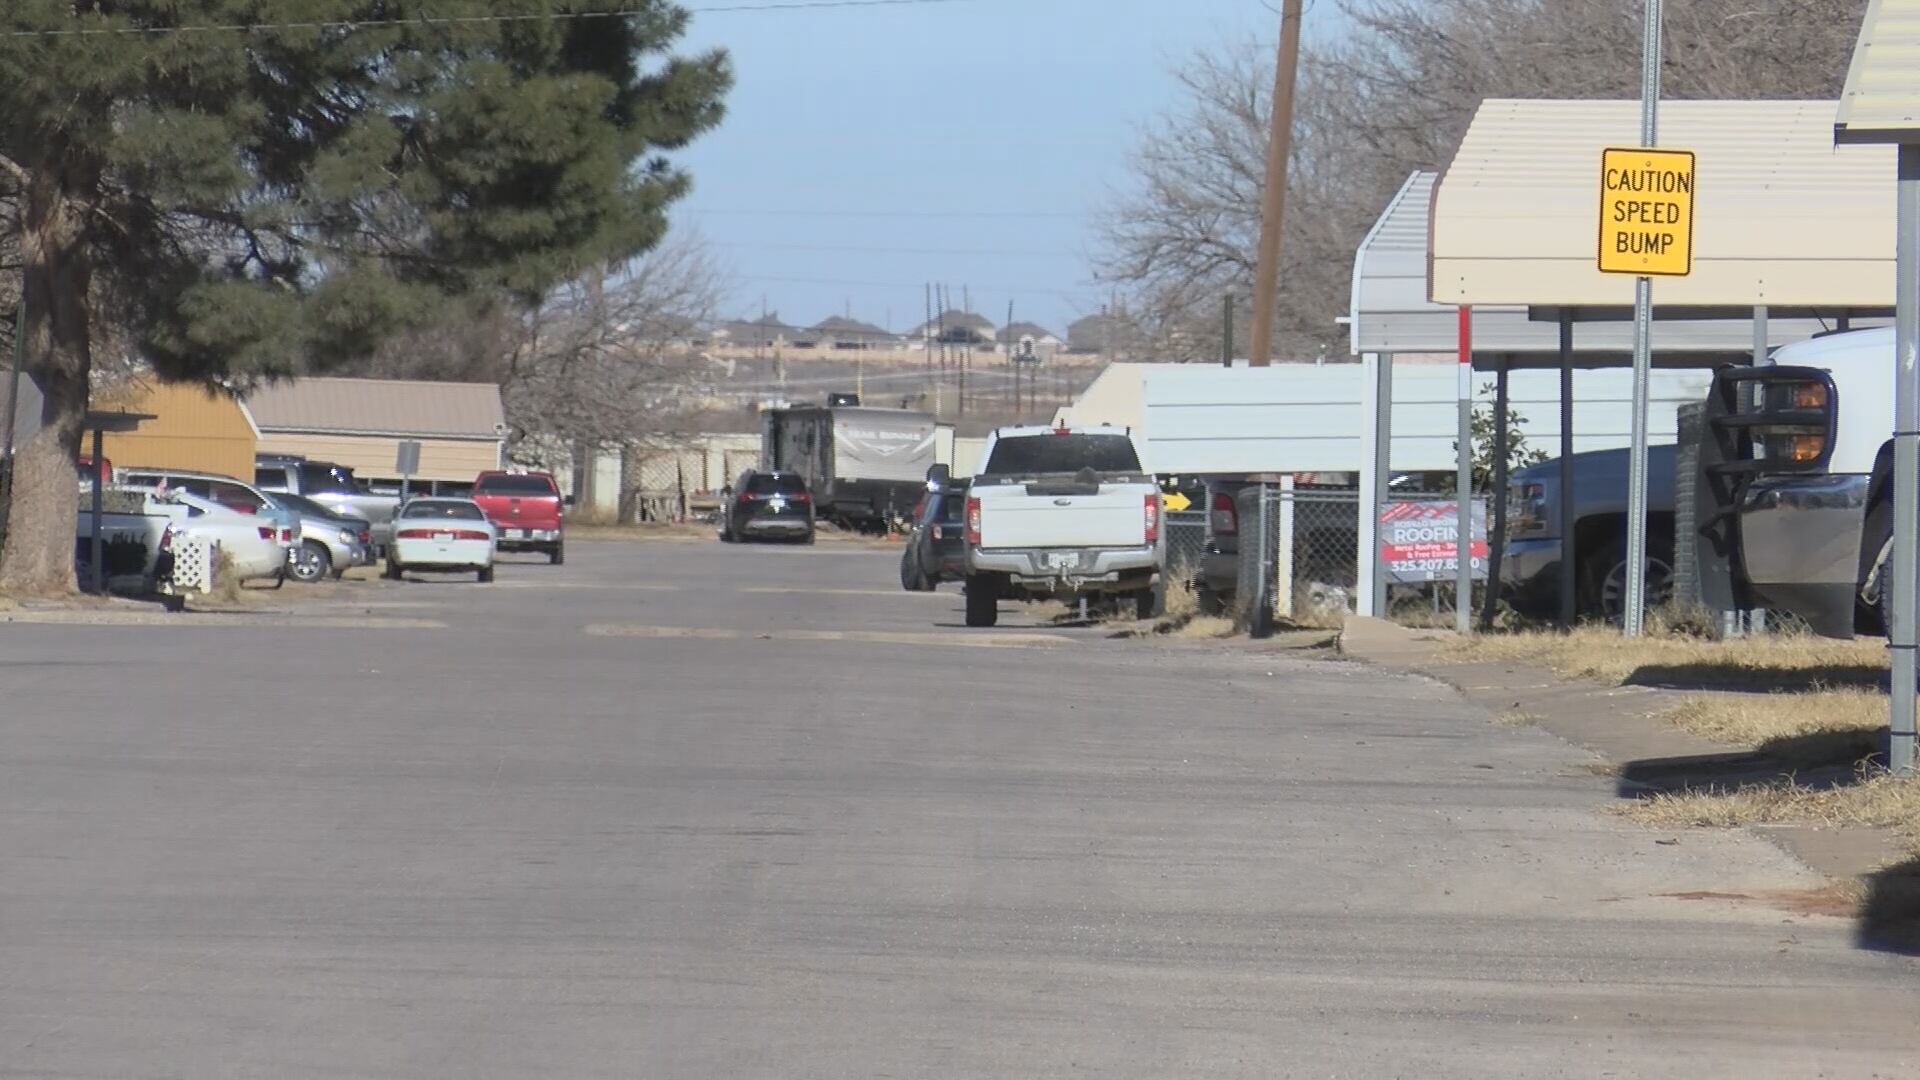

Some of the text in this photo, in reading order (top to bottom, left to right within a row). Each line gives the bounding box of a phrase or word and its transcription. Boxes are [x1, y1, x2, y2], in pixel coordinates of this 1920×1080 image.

[1606, 168, 1690, 193] CAUTION
[1614, 200, 1680, 224] SPEED
[1616, 231, 1674, 255] BUMP
[1394, 527, 1474, 542] ROOFIN
[1391, 558, 1480, 572] 325.207.80
